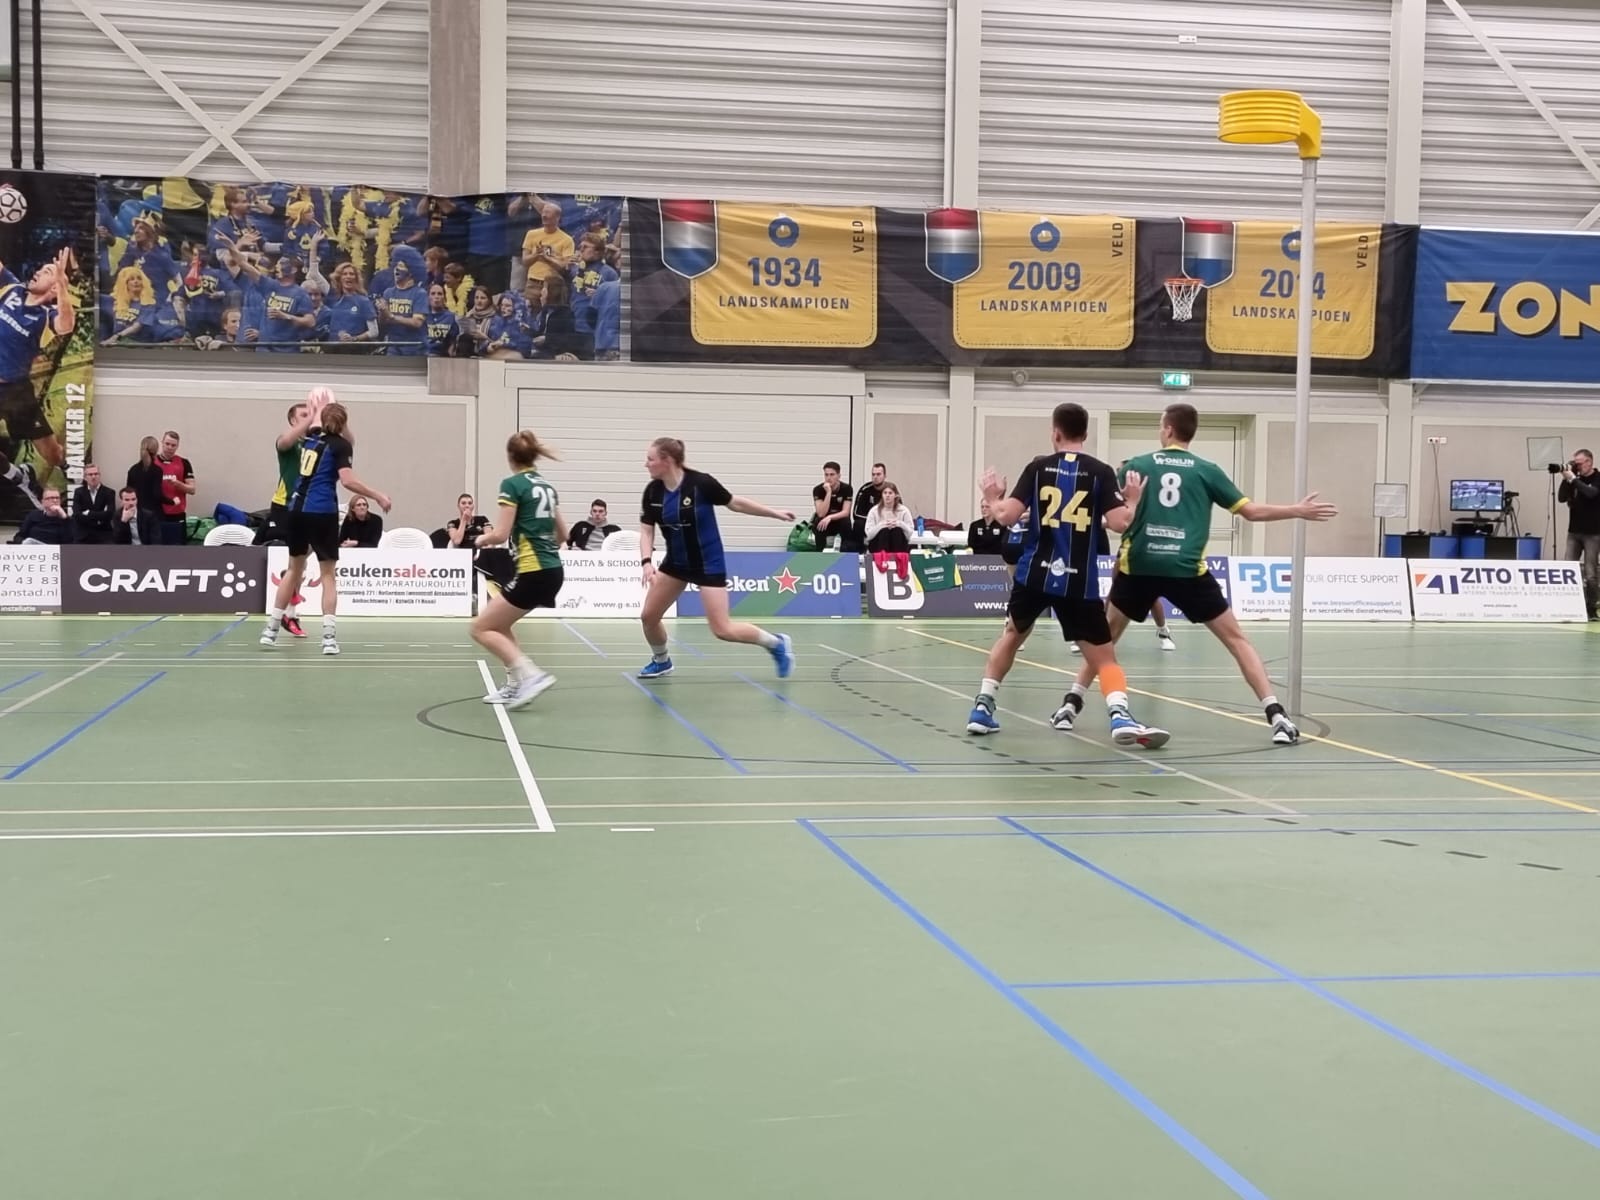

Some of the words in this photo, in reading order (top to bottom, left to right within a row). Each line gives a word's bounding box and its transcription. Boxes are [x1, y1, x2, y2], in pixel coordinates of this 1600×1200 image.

[852, 220, 865, 253] VELD
[1112, 222, 1124, 257] VELD
[1356, 235, 1369, 268] VELD
[748, 257, 822, 287] 1934
[1008, 261, 1081, 291] 2009
[1260, 269, 1326, 300] 204
[719, 295, 850, 310] LANDSKAMPIOEN
[981, 299, 1108, 313] LANDSKAMPIOEN
[1232, 305, 1351, 322] LANDSKAPIOEN
[66, 383, 86, 404] 12
[1158, 472, 1182, 508] 8
[1039, 485, 1092, 533] 24
[0, 551, 46, 562] aiweg
[52, 552, 60, 561] 8
[607, 559, 644, 568] SCHOO
[0, 576, 7, 585] 7
[15, 576, 33, 585] 43
[41, 576, 59, 585] 83
[79, 567, 219, 593] CRAFT
[1327, 574, 1359, 583] OFFICE
[1360, 574, 1400, 584] SUPPORT
[1461, 567, 1512, 585] ZITO
[1518, 568, 1578, 585] TEER
